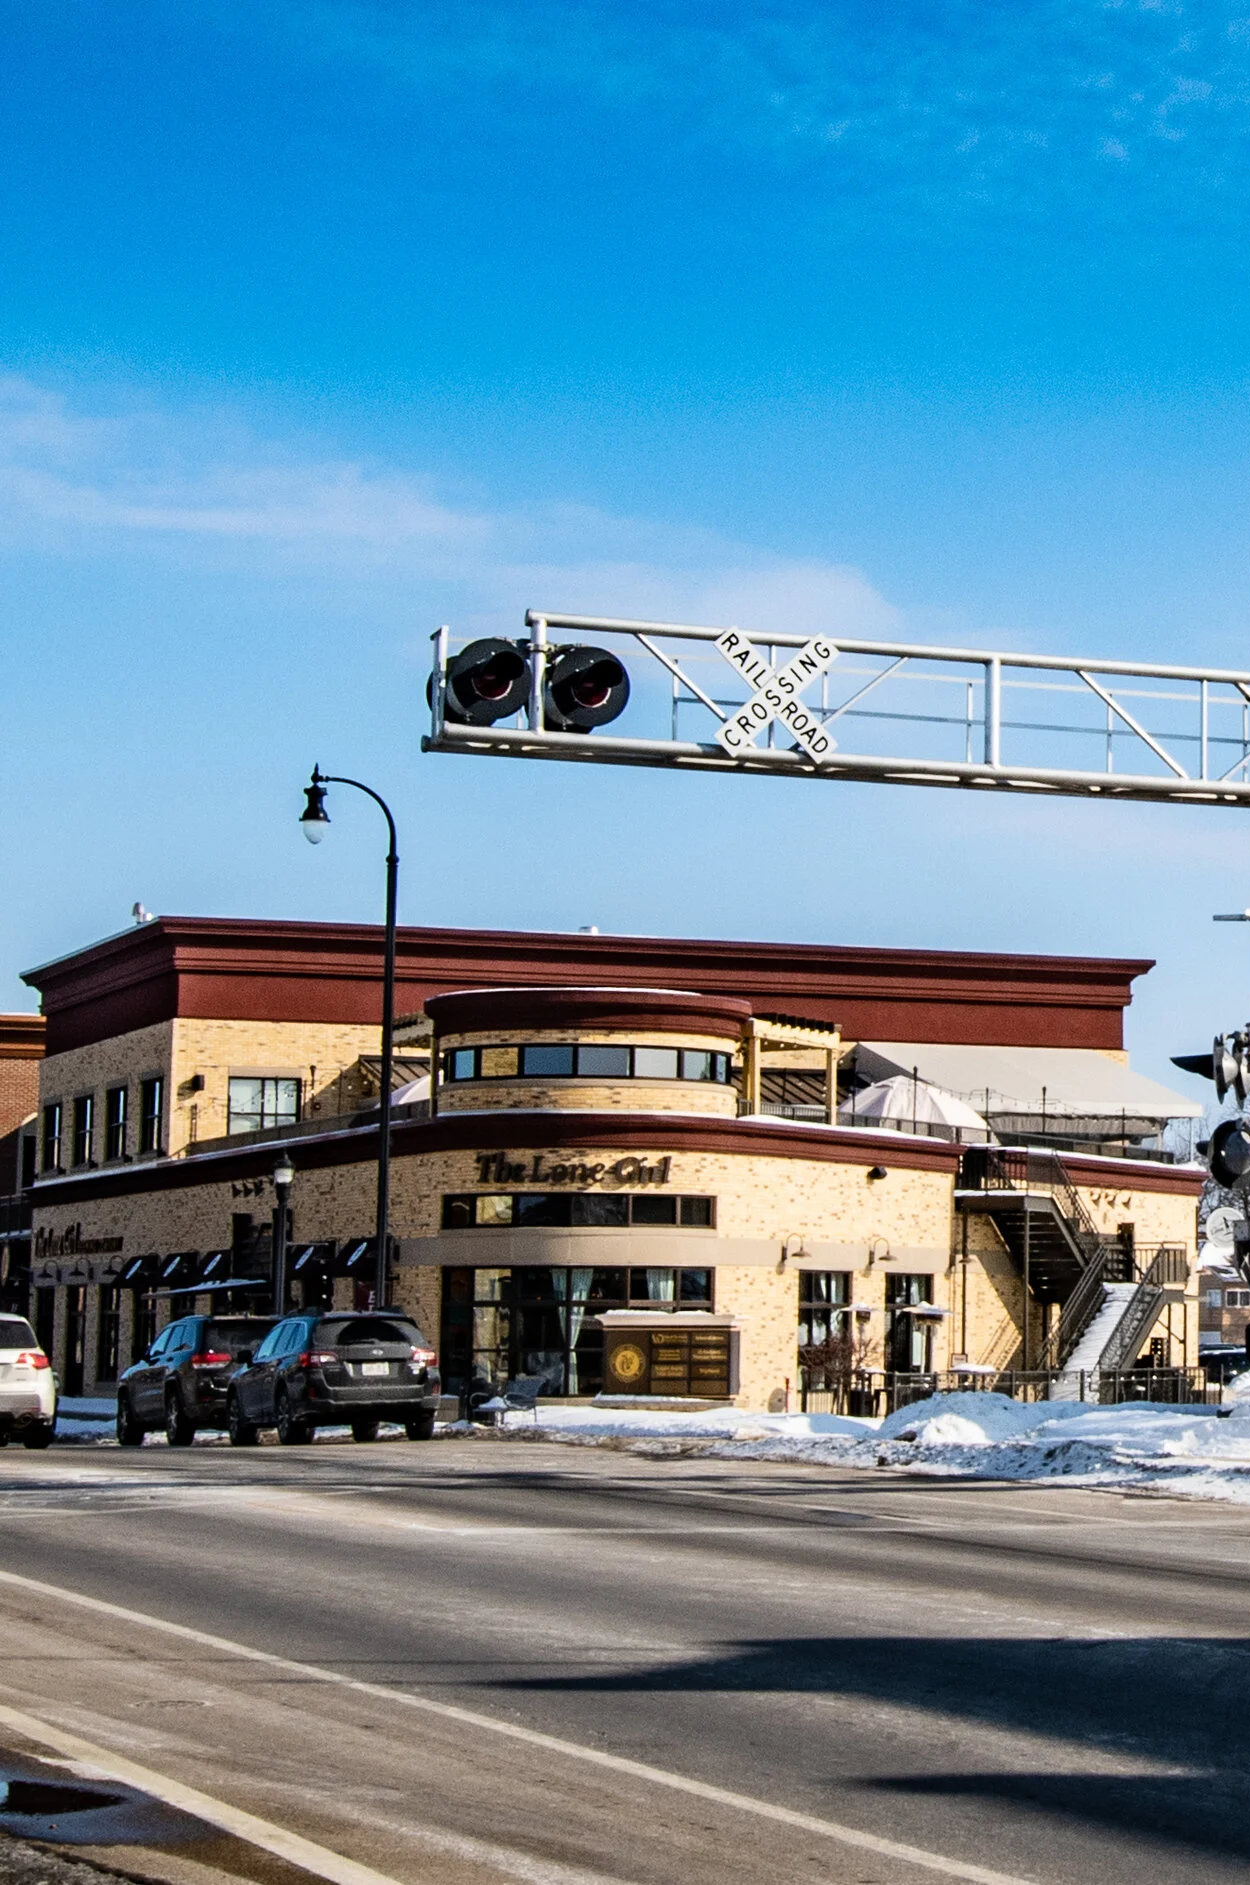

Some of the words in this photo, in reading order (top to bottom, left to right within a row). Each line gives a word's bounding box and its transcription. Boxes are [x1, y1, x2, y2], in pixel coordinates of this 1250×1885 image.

[721, 633, 766, 688] RAIL
[780, 701, 829, 753] ROAD
[724, 642, 830, 746] CROSSING
[475, 1152, 526, 1184] The
[527, 1155, 606, 1184] Lone
[611, 1155, 672, 1184] Girl
